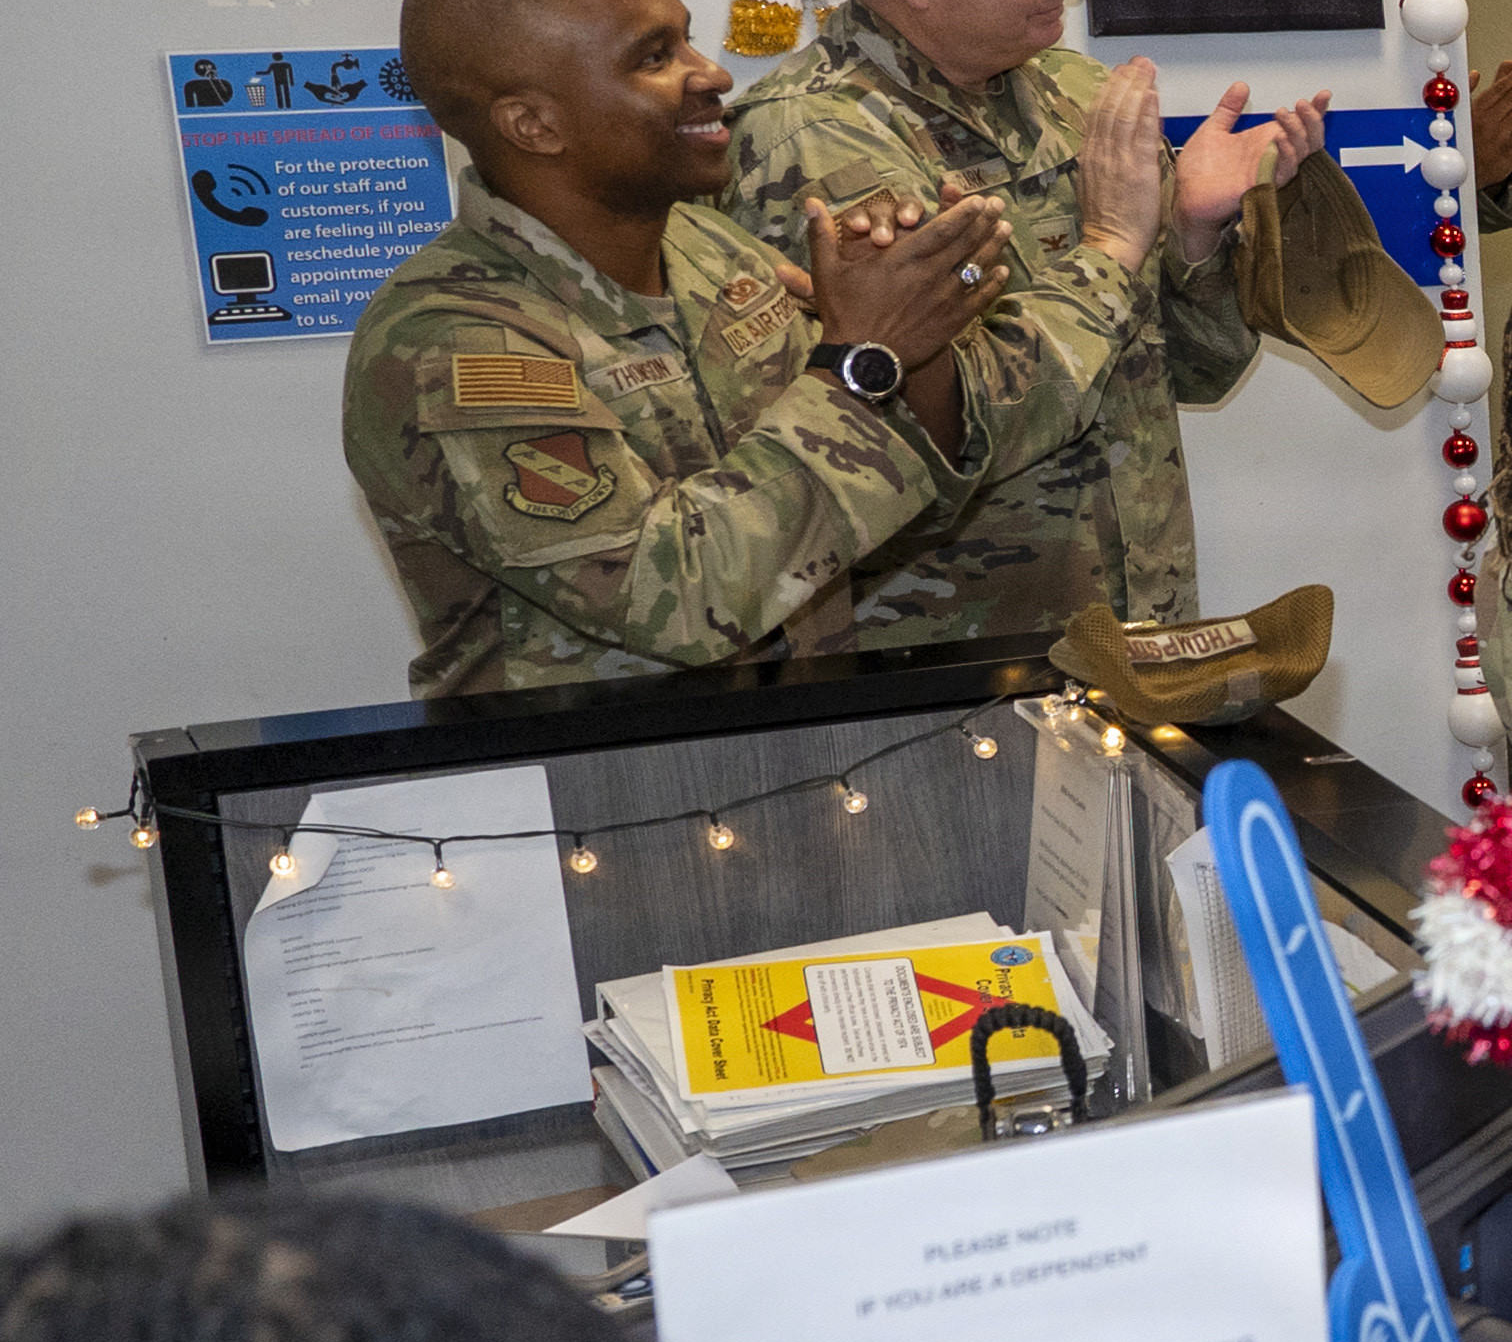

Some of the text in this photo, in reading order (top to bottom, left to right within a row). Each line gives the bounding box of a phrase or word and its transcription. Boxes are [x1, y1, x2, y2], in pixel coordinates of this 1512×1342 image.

[181, 123, 443, 148] STOP THE SPREAD OF GERMS
[275, 156, 428, 175] For the protection
[278, 177, 407, 196] of our staff and
[281, 199, 424, 218] customers, if you
[284, 220, 451, 240] are feeling ill please
[288, 244, 381, 261] reschedule
[290, 265, 397, 286] appointmen
[294, 290, 340, 305] email
[297, 313, 344, 327] to us.
[994, 968, 1013, 1003] Privacy
[923, 1218, 1080, 1264] PLEASE NOTE
[857, 1243, 1149, 1318] IF YOU ARE A DEPENDENT
